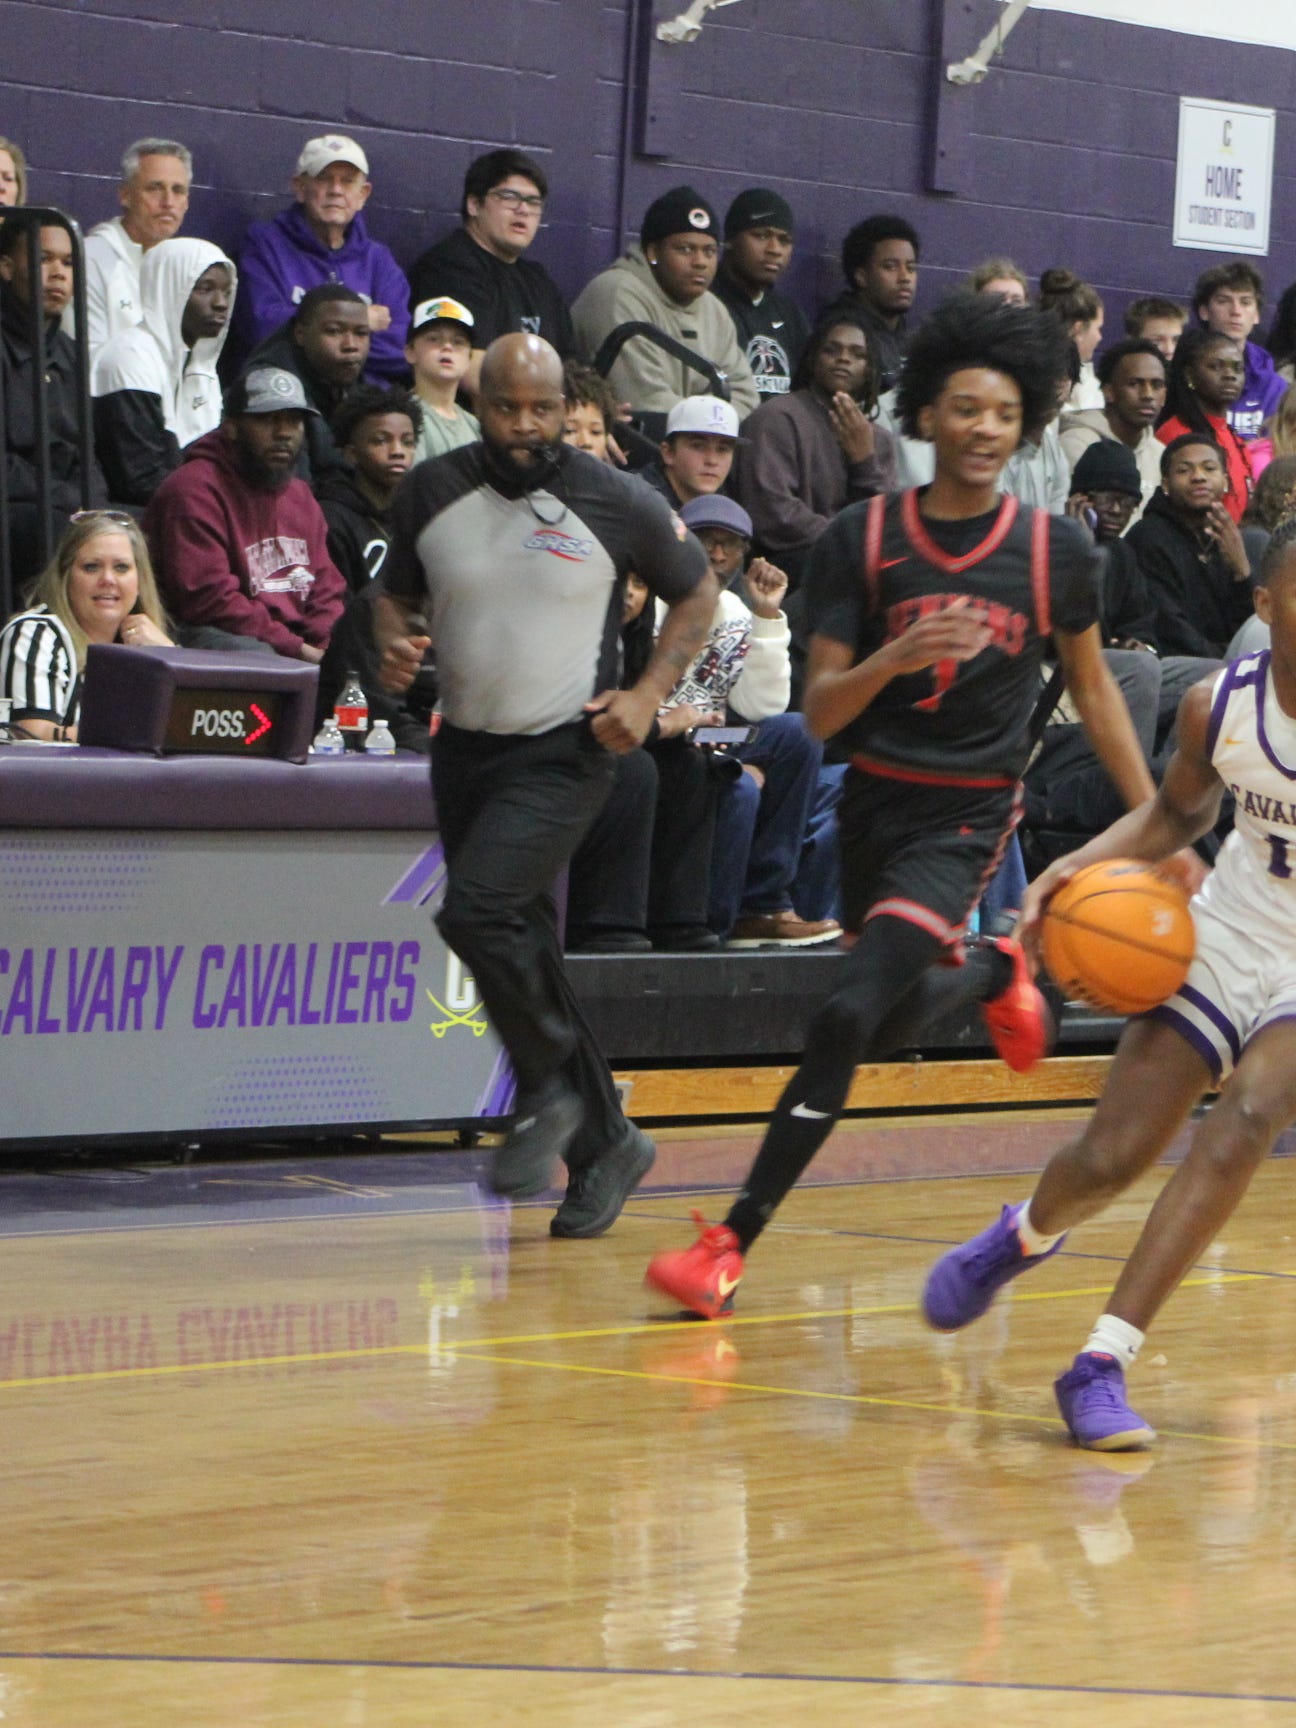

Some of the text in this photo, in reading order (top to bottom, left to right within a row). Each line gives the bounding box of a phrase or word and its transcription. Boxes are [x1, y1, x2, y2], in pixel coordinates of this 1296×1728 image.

[1205, 165, 1243, 200] HOME
[1188, 204, 1257, 231] STUDENT SECTION
[191, 709, 247, 738] POSS.
[192, 940, 421, 1029] CAVALIERS
